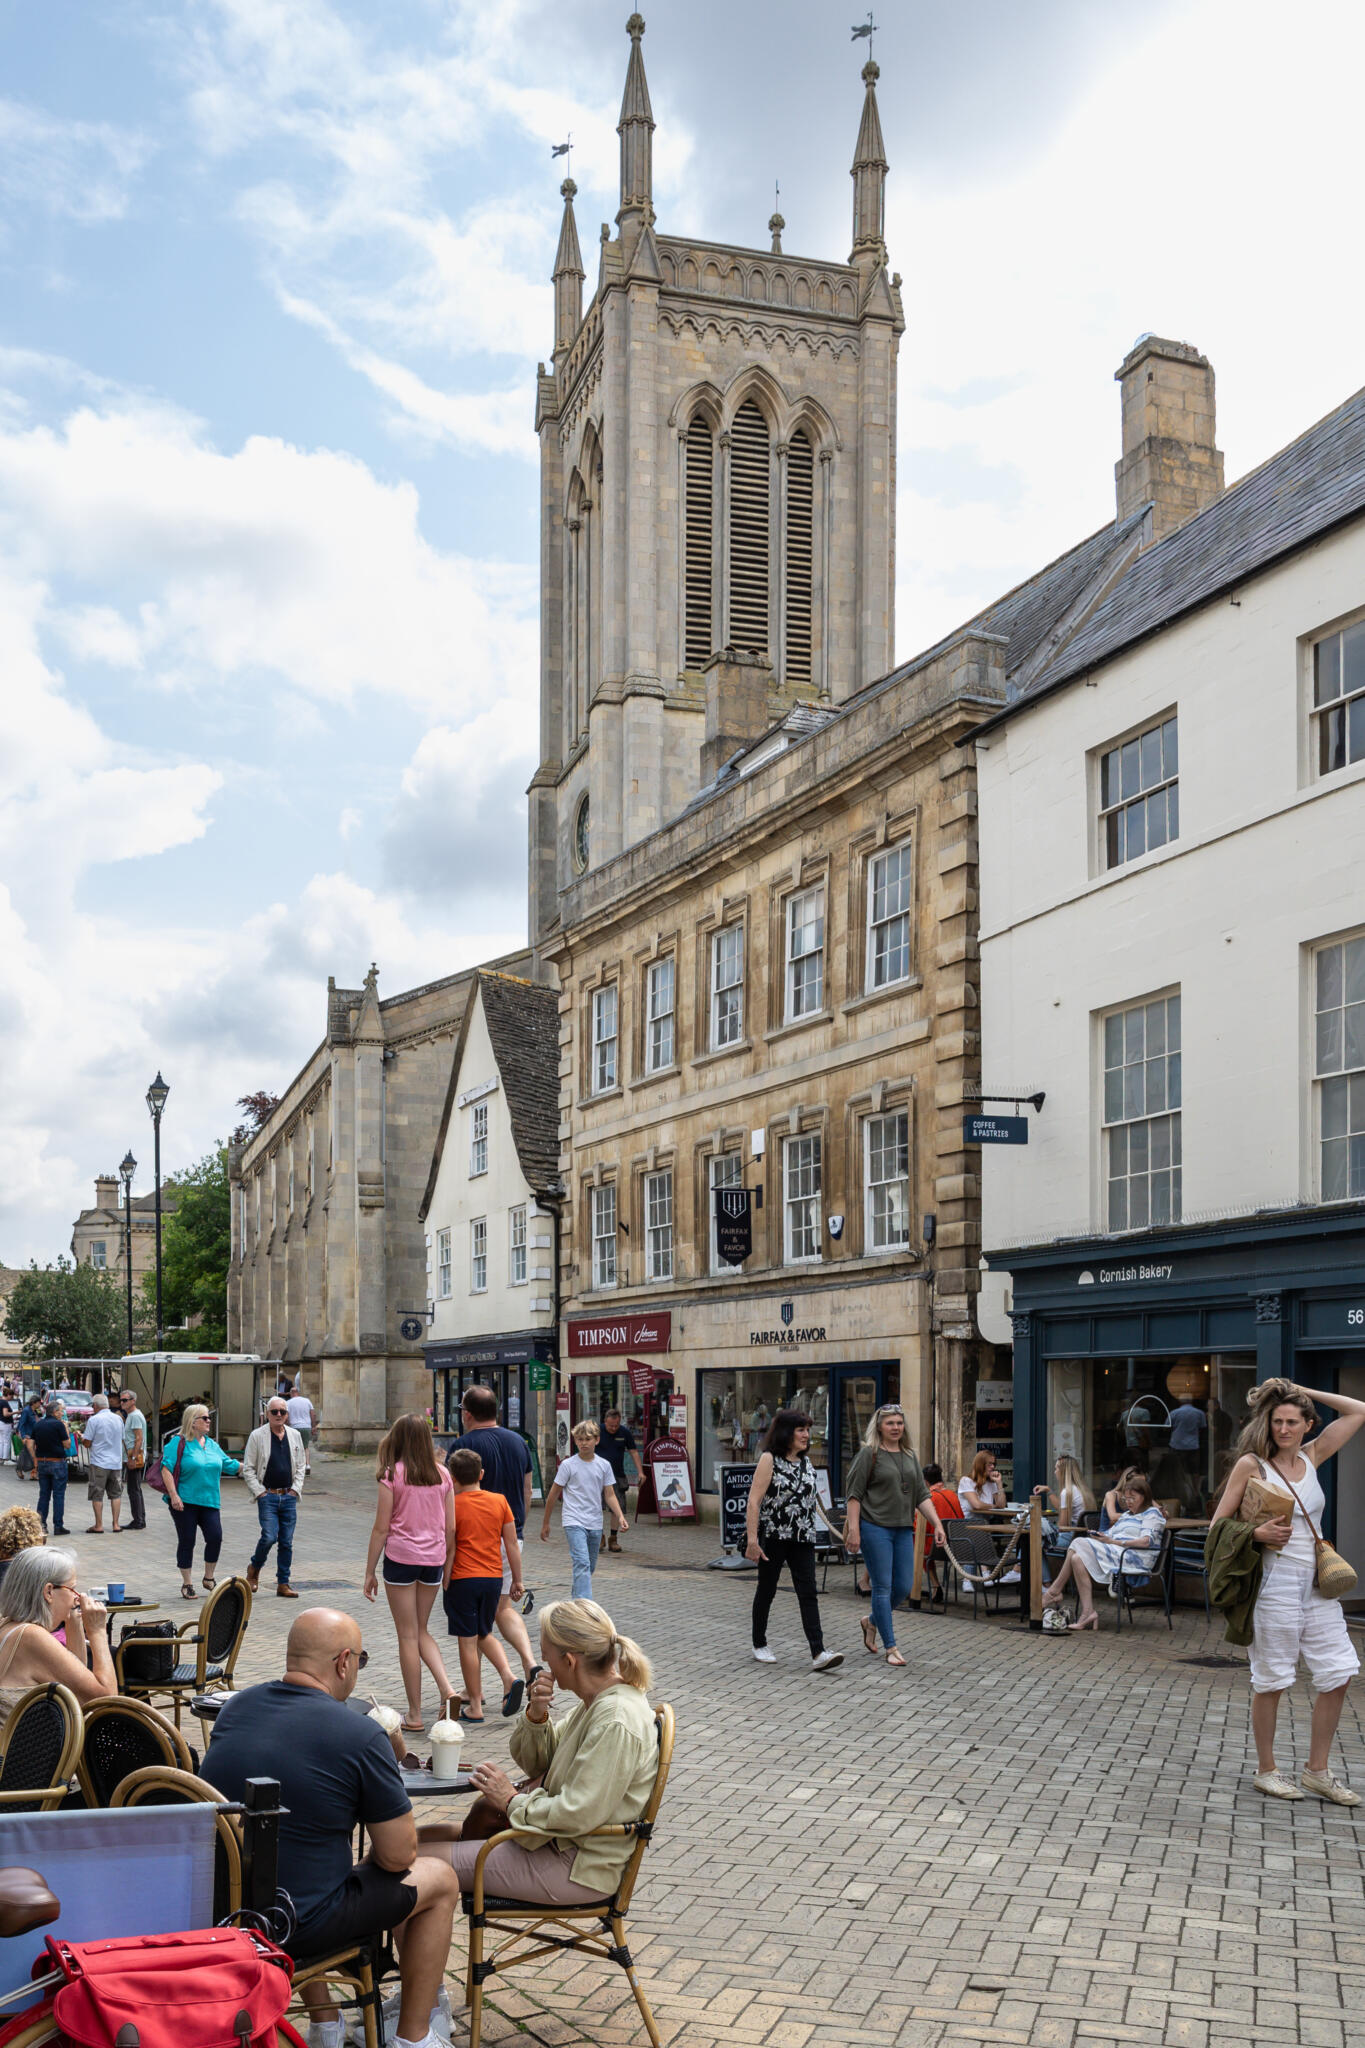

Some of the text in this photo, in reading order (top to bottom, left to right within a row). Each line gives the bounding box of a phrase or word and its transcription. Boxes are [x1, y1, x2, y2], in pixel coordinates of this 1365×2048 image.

[973, 1121, 996, 1129] COFFEE
[979, 1129, 1009, 1138] PASTRIES
[721, 1227, 748, 1235] FAIRFAX
[1100, 1264, 1172, 1283] Cornish Bakery
[1348, 1309, 1364, 1325] 56
[578, 1327, 627, 1346] TIMPSON
[750, 1327, 827, 1344] FAIRFAX & FAVOR
[726, 1474, 753, 1484] ANTIQU
[725, 1499, 746, 1512] OP
